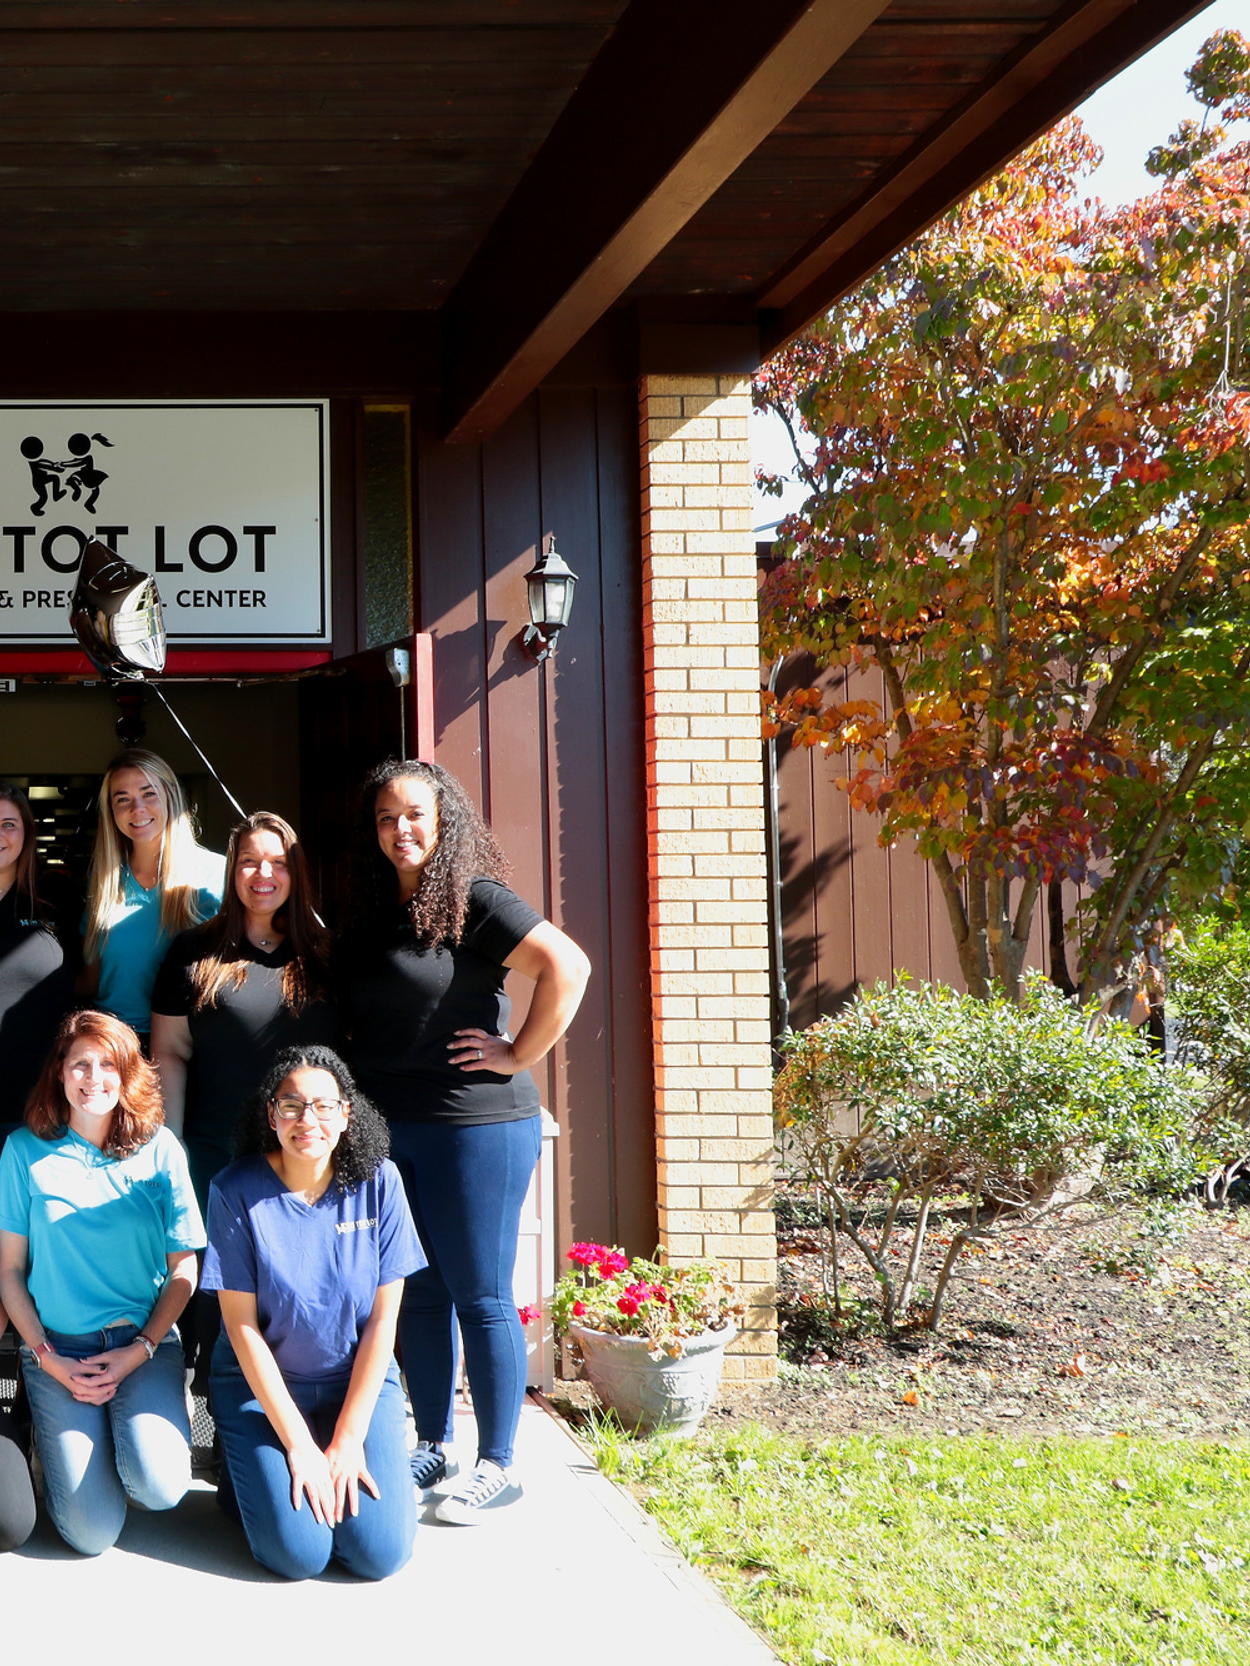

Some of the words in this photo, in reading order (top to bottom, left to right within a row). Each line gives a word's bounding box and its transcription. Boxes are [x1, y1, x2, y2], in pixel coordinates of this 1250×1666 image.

[2, 525, 129, 574] TOT
[154, 525, 277, 574] LOT
[176, 589, 267, 608] CENTER
